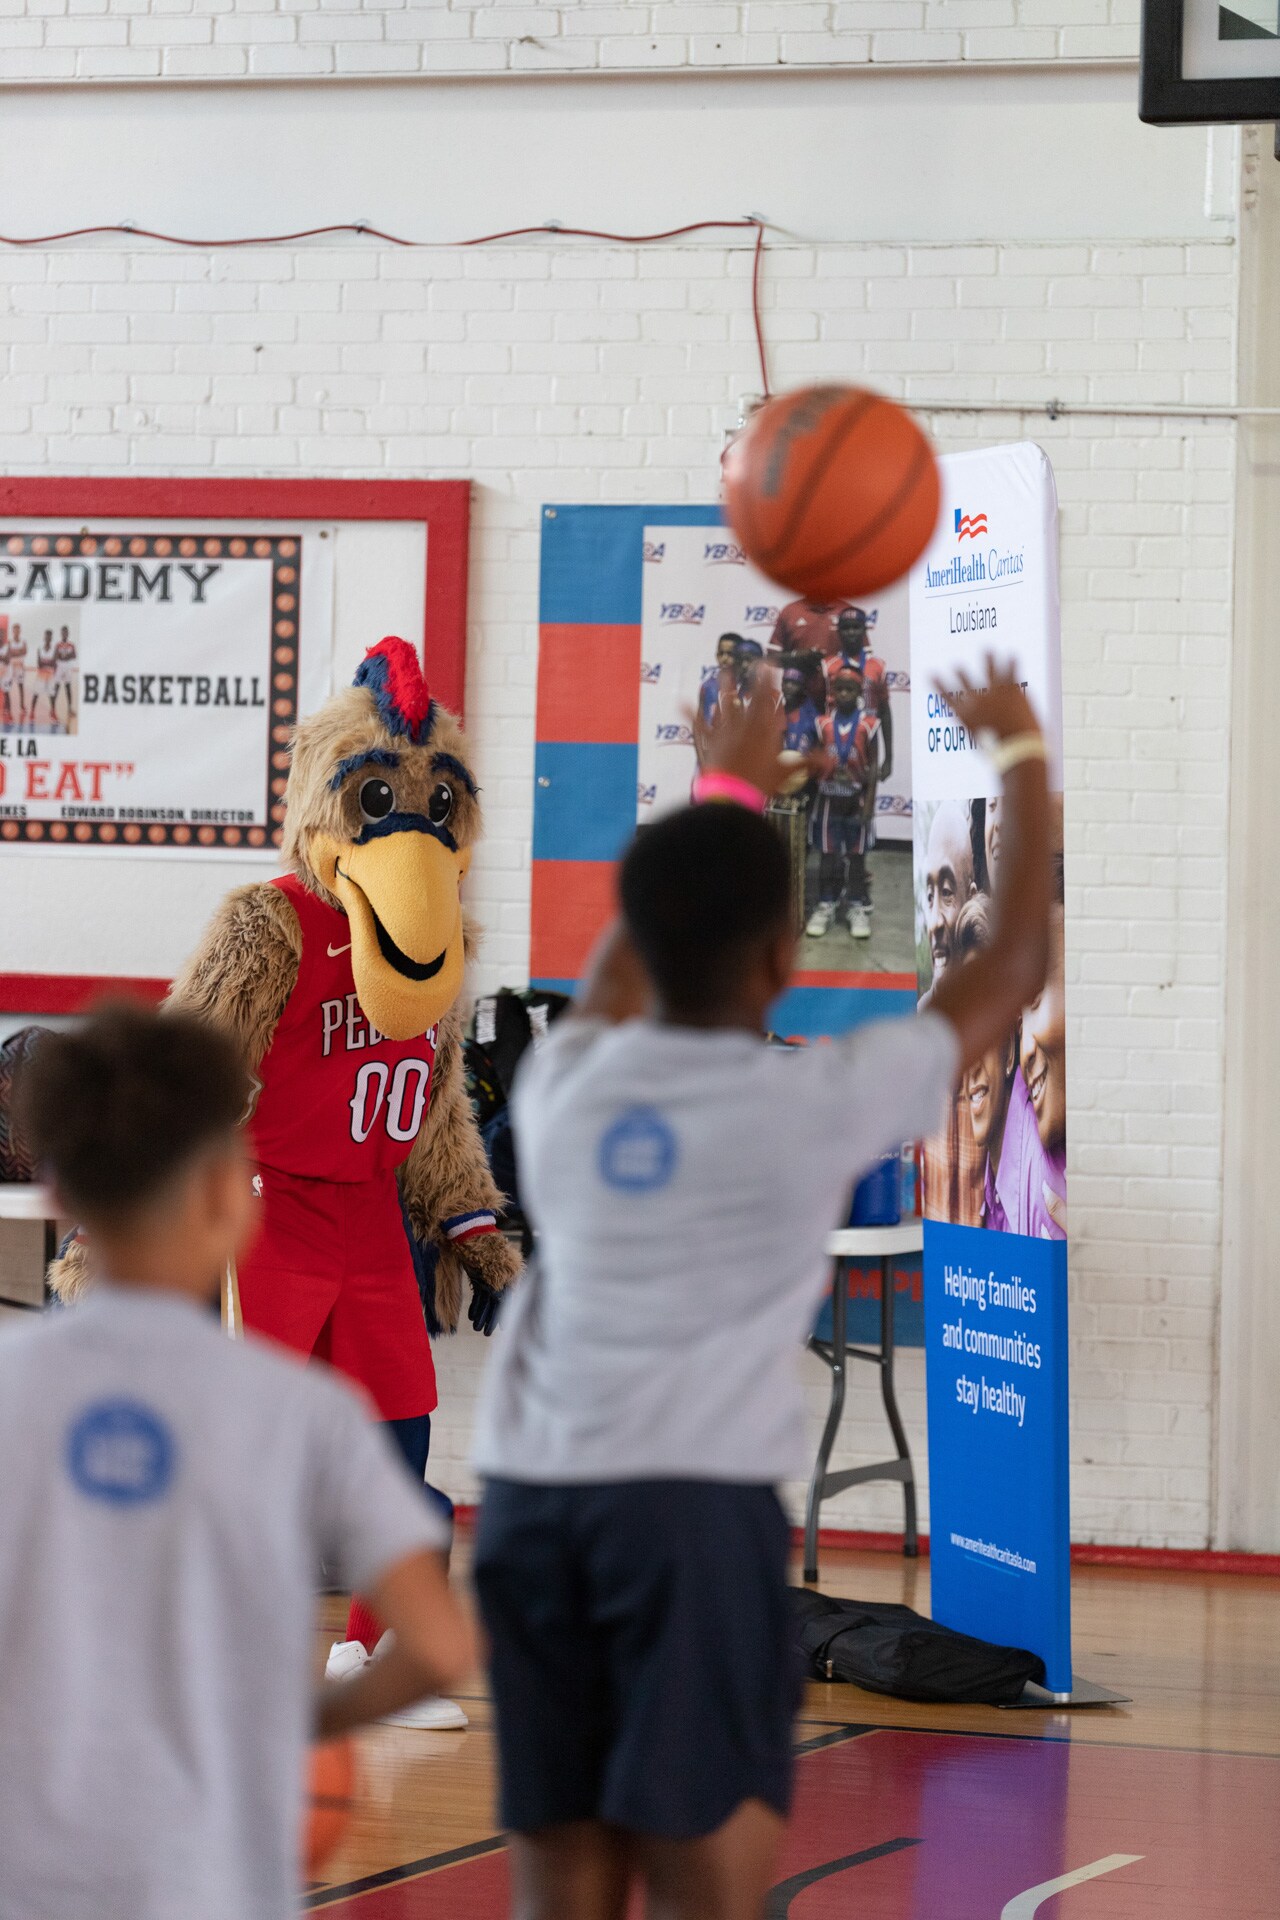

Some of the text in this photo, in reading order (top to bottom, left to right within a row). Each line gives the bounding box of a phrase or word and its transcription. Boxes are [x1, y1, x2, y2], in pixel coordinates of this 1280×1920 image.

[925, 548, 1025, 588] AmeriHealth Caritas
[949, 601, 997, 634] Louisiana
[83, 674, 266, 706] BASKETBALL
[17, 739, 38, 757] LA
[928, 727, 941, 752] OF
[944, 725, 965, 752] OUR
[61, 806, 115, 818] EDWARD
[190, 809, 255, 822] DIRECTOR
[350, 1057, 430, 1143] 00
[944, 1265, 1036, 1314] Helping families
[943, 1318, 1041, 1369] and communities
[956, 1374, 1026, 1428] stay healthy
